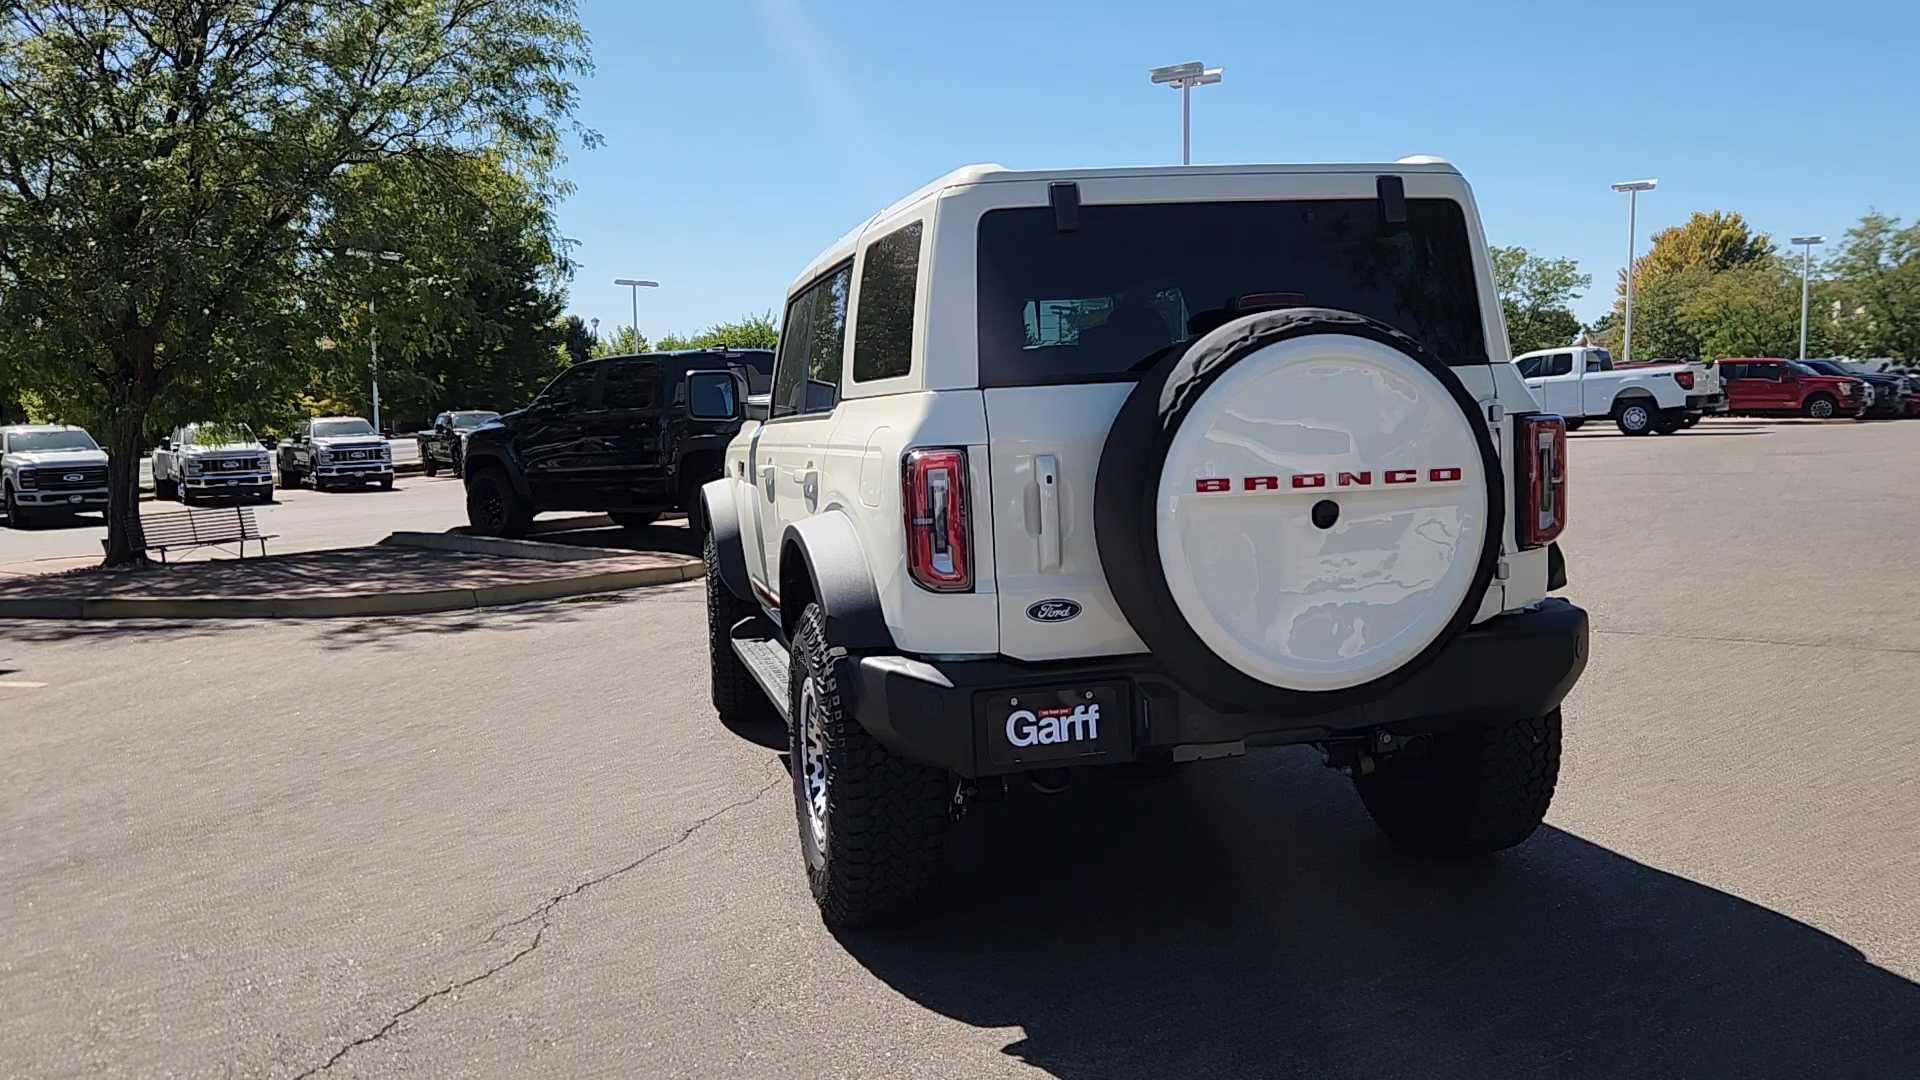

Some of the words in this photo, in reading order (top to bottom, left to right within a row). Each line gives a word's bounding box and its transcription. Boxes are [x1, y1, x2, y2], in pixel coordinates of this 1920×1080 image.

[1196, 467, 1462, 492] BRONCO
[1037, 603, 1071, 619] Ford
[1006, 704, 1100, 747] Garff
